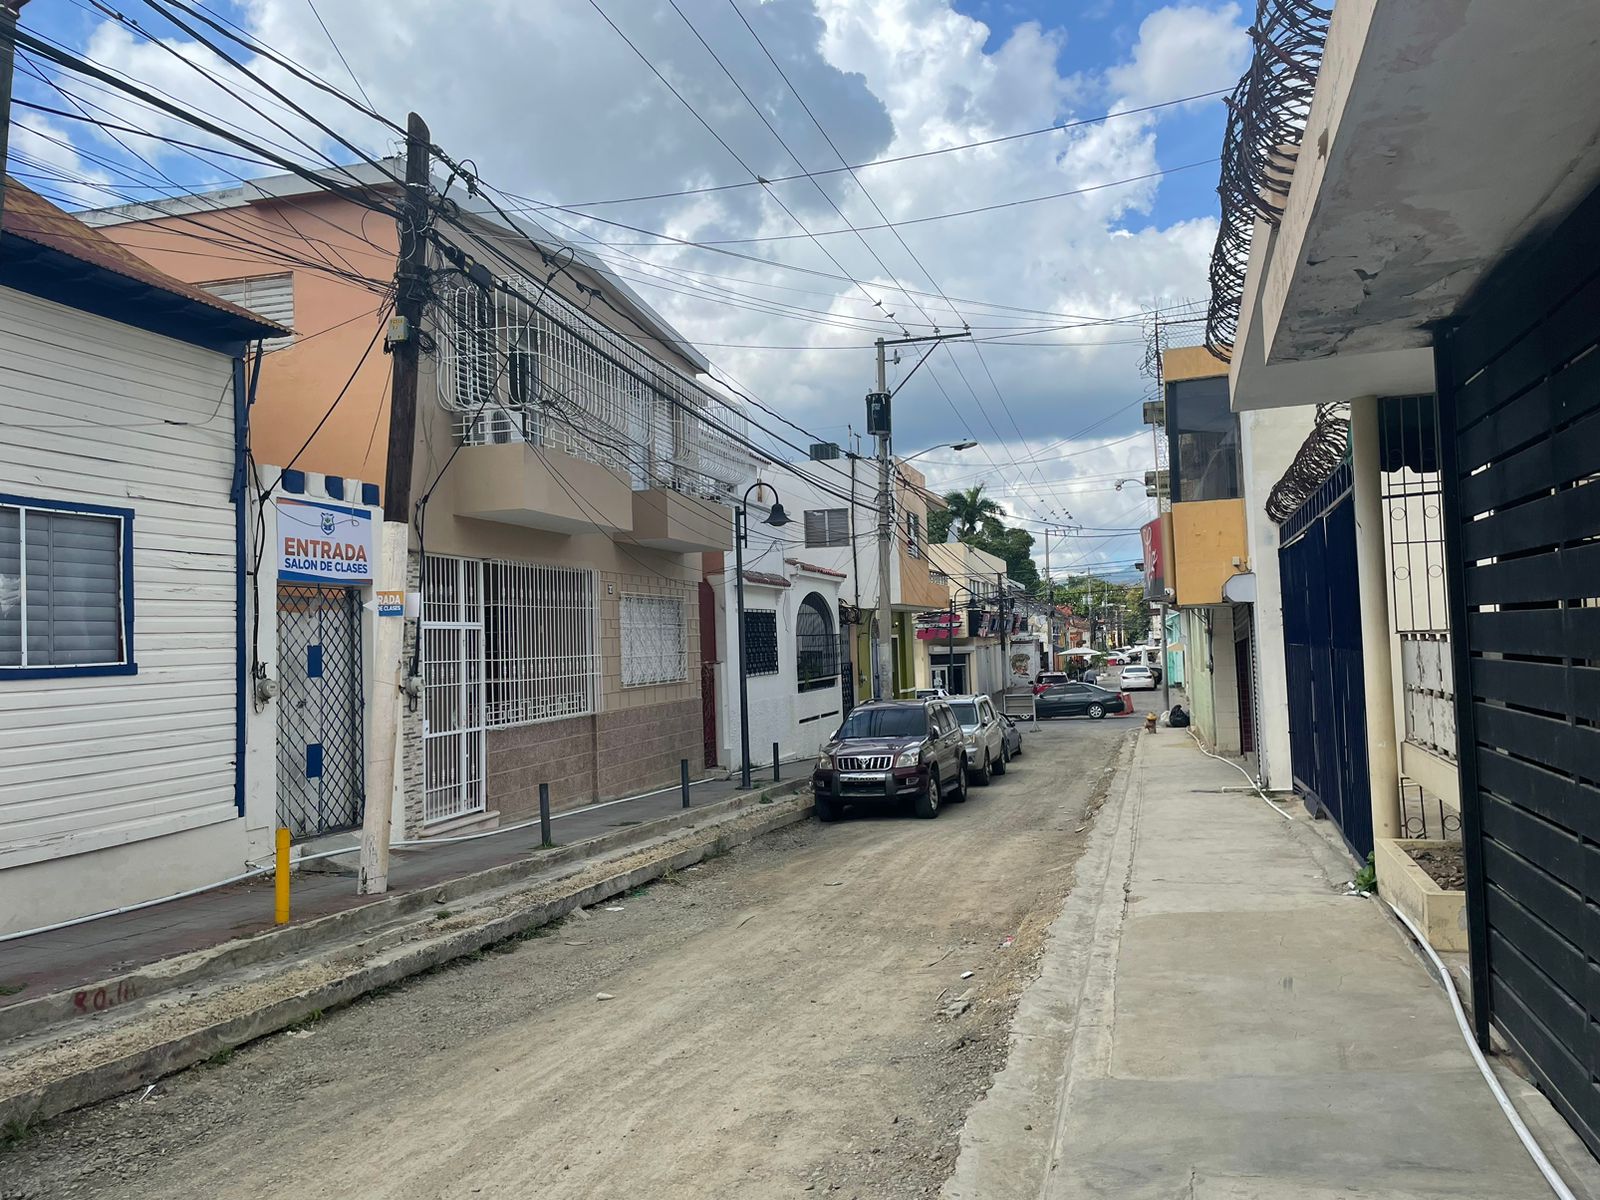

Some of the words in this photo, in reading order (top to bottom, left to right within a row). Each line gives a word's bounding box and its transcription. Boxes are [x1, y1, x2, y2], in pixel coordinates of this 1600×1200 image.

[284, 537, 367, 562] ENTRADA
[284, 557, 318, 570] SALON
[320, 561, 332, 571] DE
[334, 562, 368, 573] CLASES
